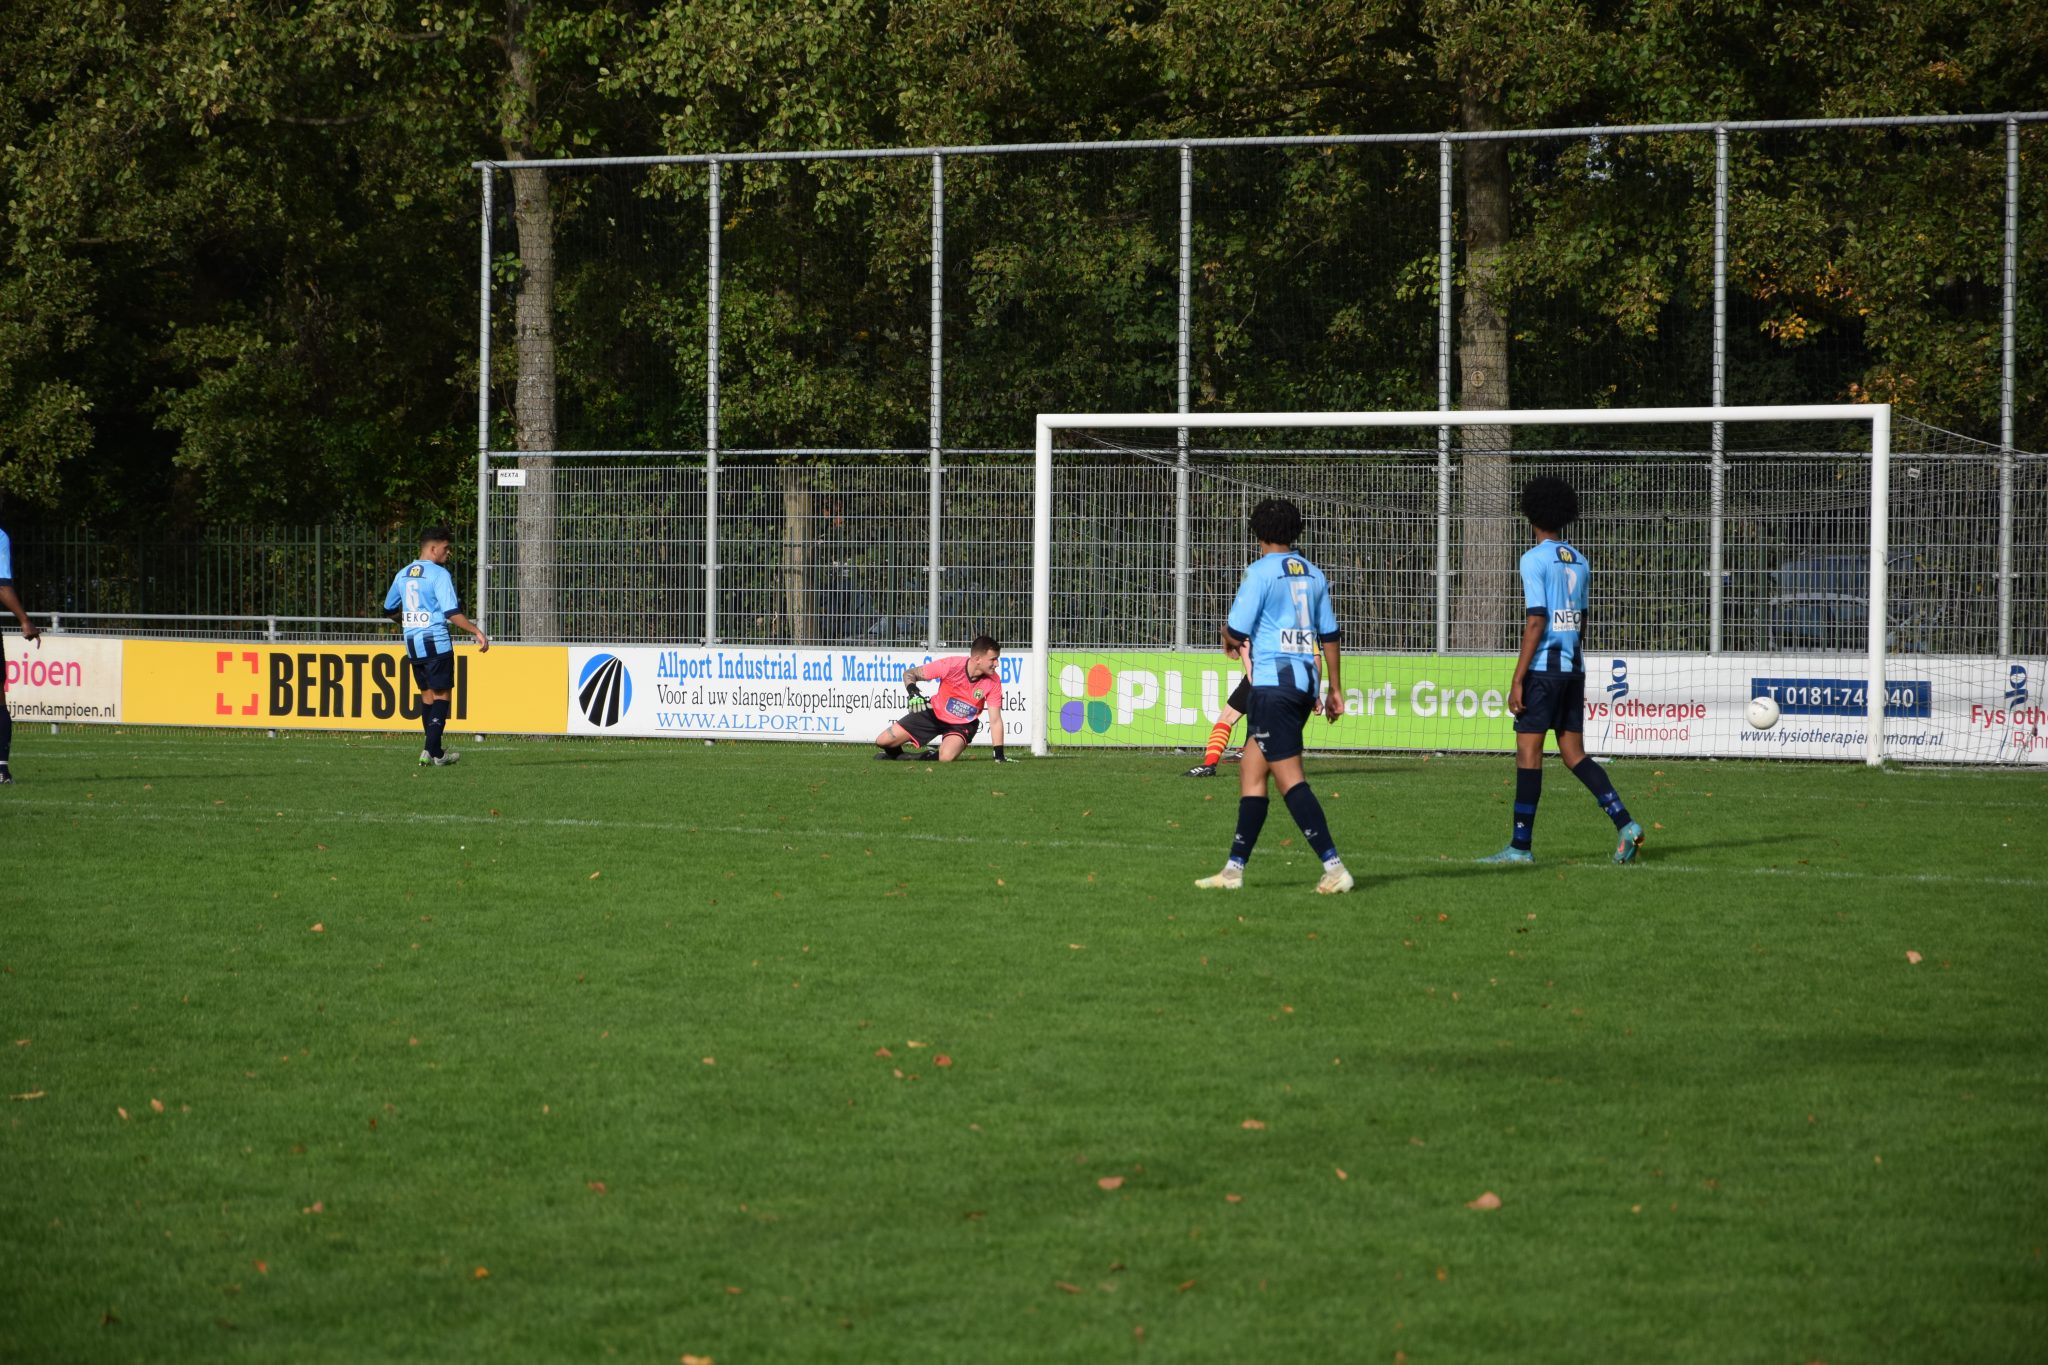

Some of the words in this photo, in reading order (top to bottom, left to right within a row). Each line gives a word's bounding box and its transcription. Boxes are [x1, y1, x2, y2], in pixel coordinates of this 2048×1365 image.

[405, 580, 419, 611] 6
[1289, 580, 1310, 627] 5
[1281, 630, 1313, 645] NEK
[657, 651, 712, 686] Allport
[718, 652, 798, 680] Industrial
[803, 653, 833, 682] and
[999, 657, 1024, 684] BV
[269, 652, 468, 720] BERTSCI
[657, 684, 688, 705] Voor
[691, 686, 703, 705] al
[708, 690, 728, 705] uw
[732, 685, 931, 714] slangen/koppelingen/afslu
[1117, 670, 1243, 725] PLU
[1411, 680, 1515, 718] Groe
[1786, 686, 1914, 708] 0181-7440
[657, 712, 845, 732] WWW.ALLPORT.NL
[1615, 723, 1689, 744] Rijnmond
[1740, 728, 1944, 748] www.fysiotherapiemond.nl
[2013, 731, 2048, 752] Rijn
